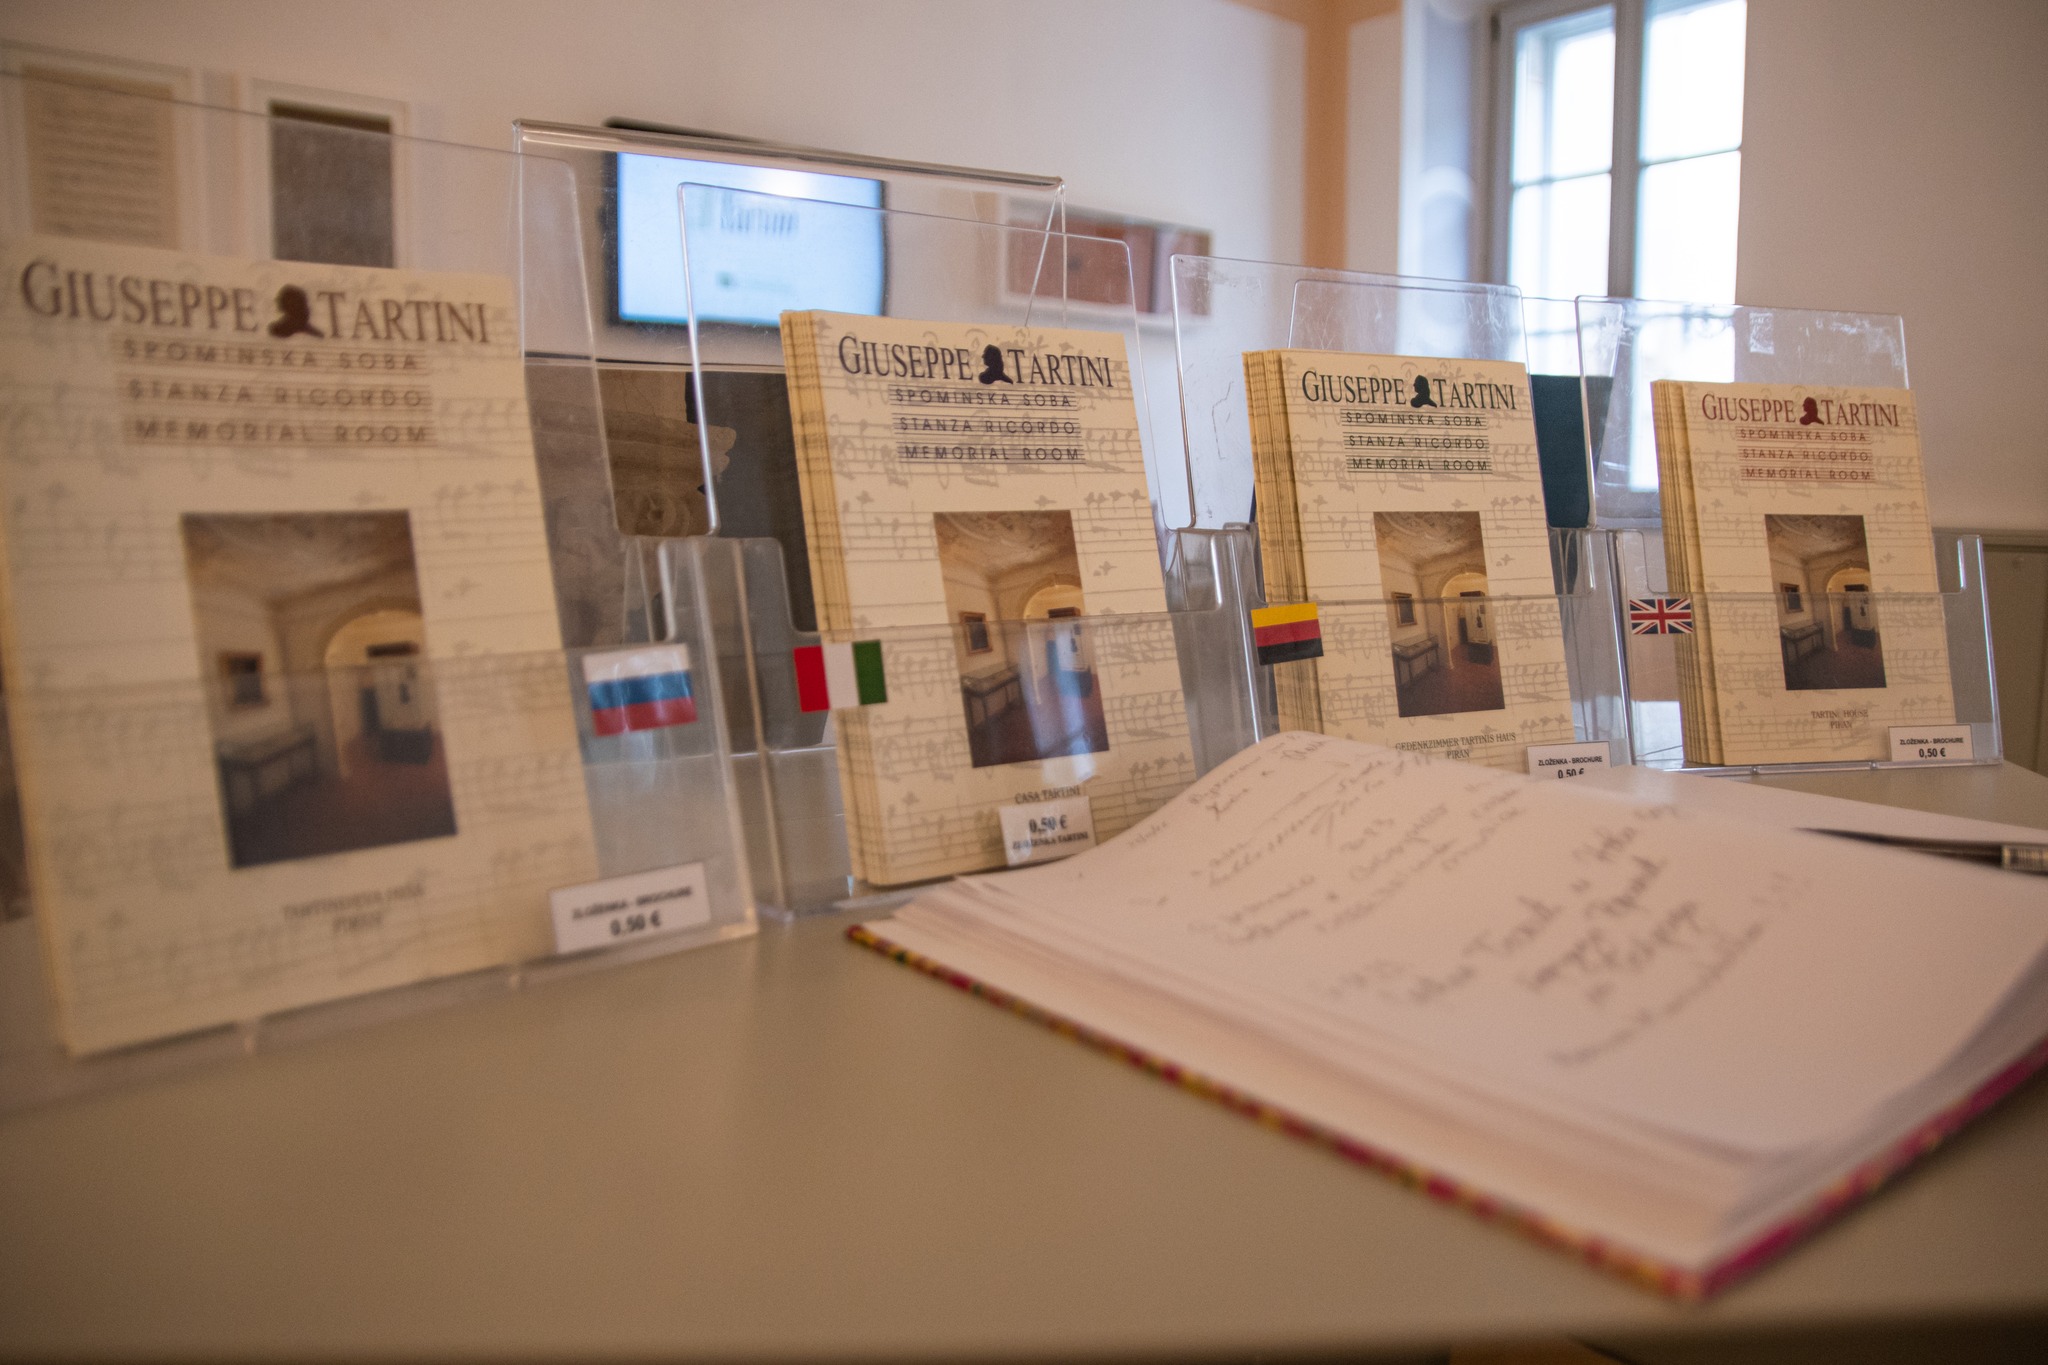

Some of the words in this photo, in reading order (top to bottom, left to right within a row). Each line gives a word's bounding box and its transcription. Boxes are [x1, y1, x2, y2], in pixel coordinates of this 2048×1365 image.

[20, 259, 258, 332] GIUSEPPE
[318, 290, 491, 343] TARTINI
[123, 339, 319, 369] SPOMINSKA
[339, 350, 418, 371] SOBA
[839, 336, 973, 381] GIUSEPPE
[1007, 349, 1113, 387] TARTINI
[128, 379, 252, 405] STANZA
[275, 386, 424, 408] RICORDO
[896, 388, 1011, 406] SPOMINSKA
[1023, 393, 1071, 407] SOBA
[1302, 370, 1406, 405] GIUSEPPE
[1433, 378, 1517, 410] TARTINI
[1702, 393, 1796, 423] GIUSEPPE
[1820, 399, 1900, 427] TARTINI
[901, 417, 973, 432] STANZA
[986, 420, 1075, 434] RICORDO
[1346, 412, 1435, 425] SPOMINSKA
[1444, 415, 1482, 427] SOBA
[135, 419, 312, 443] MEMORIAL
[335, 424, 428, 444] ROOM
[1740, 428, 1822, 441] SPOMINSKA
[1831, 431, 1866, 442] SOBA
[1349, 435, 1406, 447] STANZA
[1415, 437, 1485, 449] RICORDO
[905, 445, 1009, 460] MEMORIAL
[1023, 447, 1079, 460] ROOM
[1743, 449, 1795, 459] STANZA
[1803, 450, 1869, 461] RICORDO
[1353, 457, 1434, 470] MEMORIAL
[1443, 459, 1488, 471] ROOM
[1746, 468, 1820, 479] MEMORIAL
[1829, 469, 1871, 480] ROOM
[1395, 737, 1460, 751] GEDENKZIMMER
[1461, 734, 1495, 746] TARTINIS
[1496, 732, 1516, 743] HAUS
[1446, 748, 1470, 759] PIRAN
[1919, 748, 1937, 759] 0,50
[1940, 747, 1946, 757] €
[1538, 758, 1568, 766] ZLOŽENKA
[1572, 756, 1603, 764] BROCHURE
[1015, 791, 1040, 804] CASA
